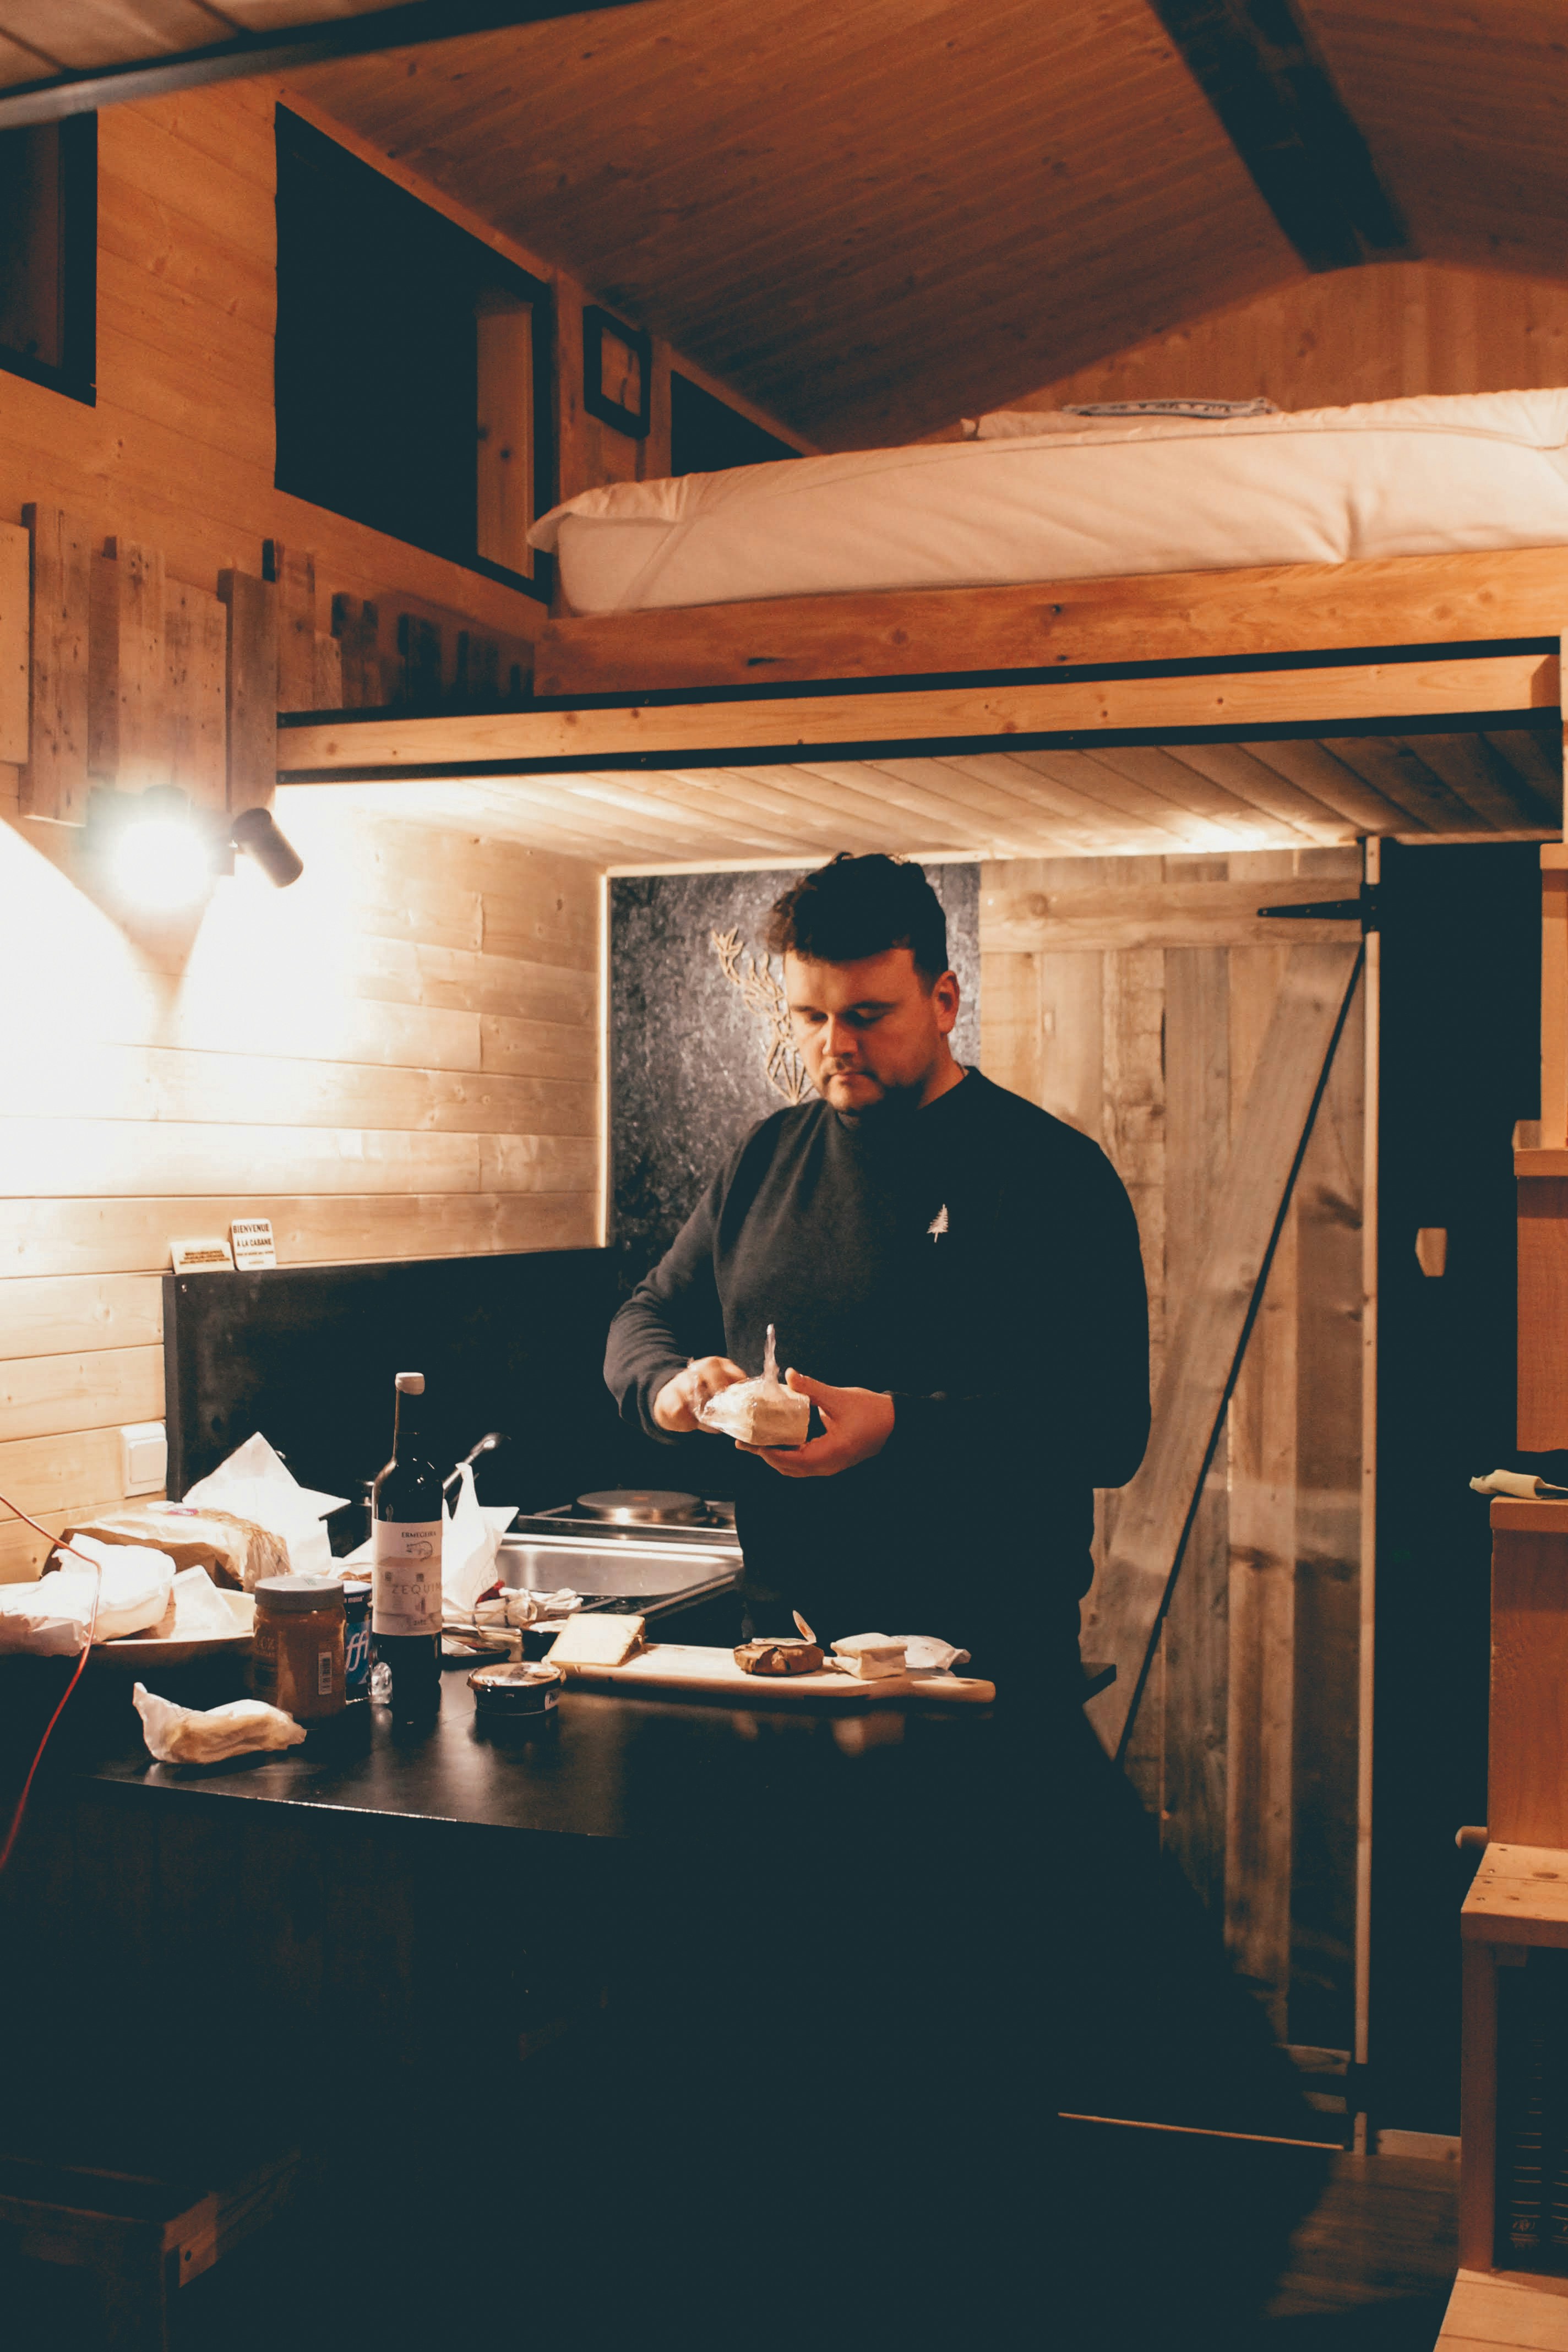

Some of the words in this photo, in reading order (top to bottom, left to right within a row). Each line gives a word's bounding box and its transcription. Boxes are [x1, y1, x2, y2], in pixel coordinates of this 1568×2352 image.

[233, 1224, 269, 1234] BIENVENUE
[242, 1239, 249, 1247] LA
[251, 1238, 272, 1246] CABANE
